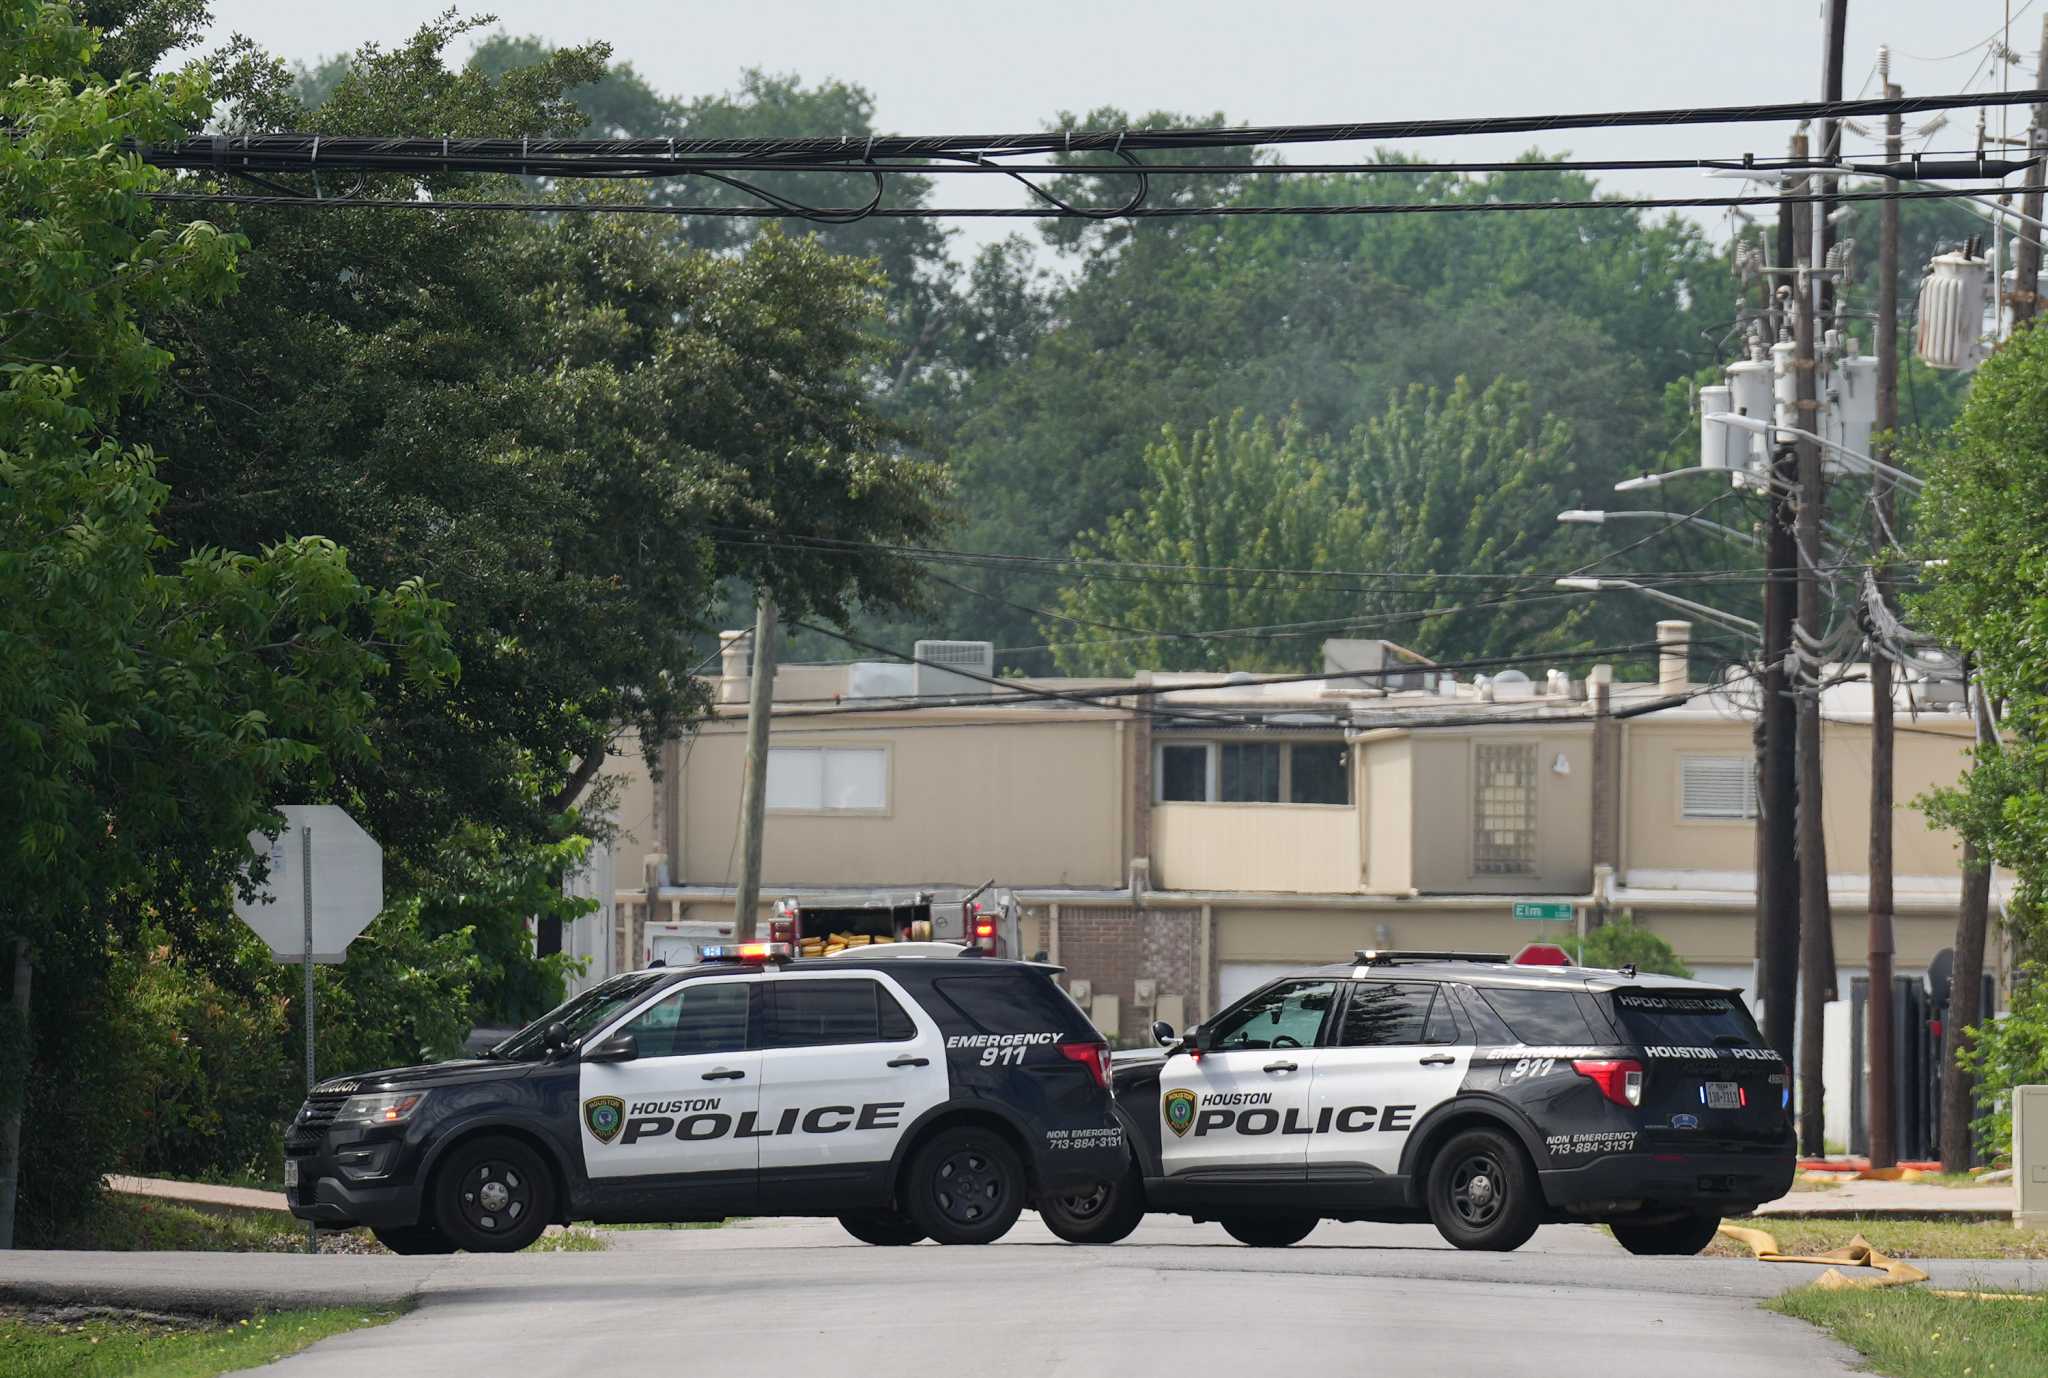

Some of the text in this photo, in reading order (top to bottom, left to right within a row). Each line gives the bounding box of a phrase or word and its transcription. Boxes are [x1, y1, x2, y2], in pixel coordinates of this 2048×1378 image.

[1516, 904, 1542, 917] Elm
[947, 1033, 1063, 1048] EMERGENCY
[980, 1046, 1027, 1067] 911
[1644, 1046, 1783, 1061] HOUSTON POLICE
[1511, 1058, 1556, 1077] 911
[630, 1098, 721, 1115] HOUSTON
[1202, 1092, 1272, 1106] HOUSTON
[620, 1101, 905, 1145] POLICE
[1194, 1105, 1416, 1137] POLICE
[1046, 1127, 1121, 1139] NON EMERGENCY
[1546, 1131, 1638, 1145] NON EMERGENCY
[1049, 1136, 1122, 1149] 713-884-3131
[1550, 1140, 1634, 1156] 713-884-3131
